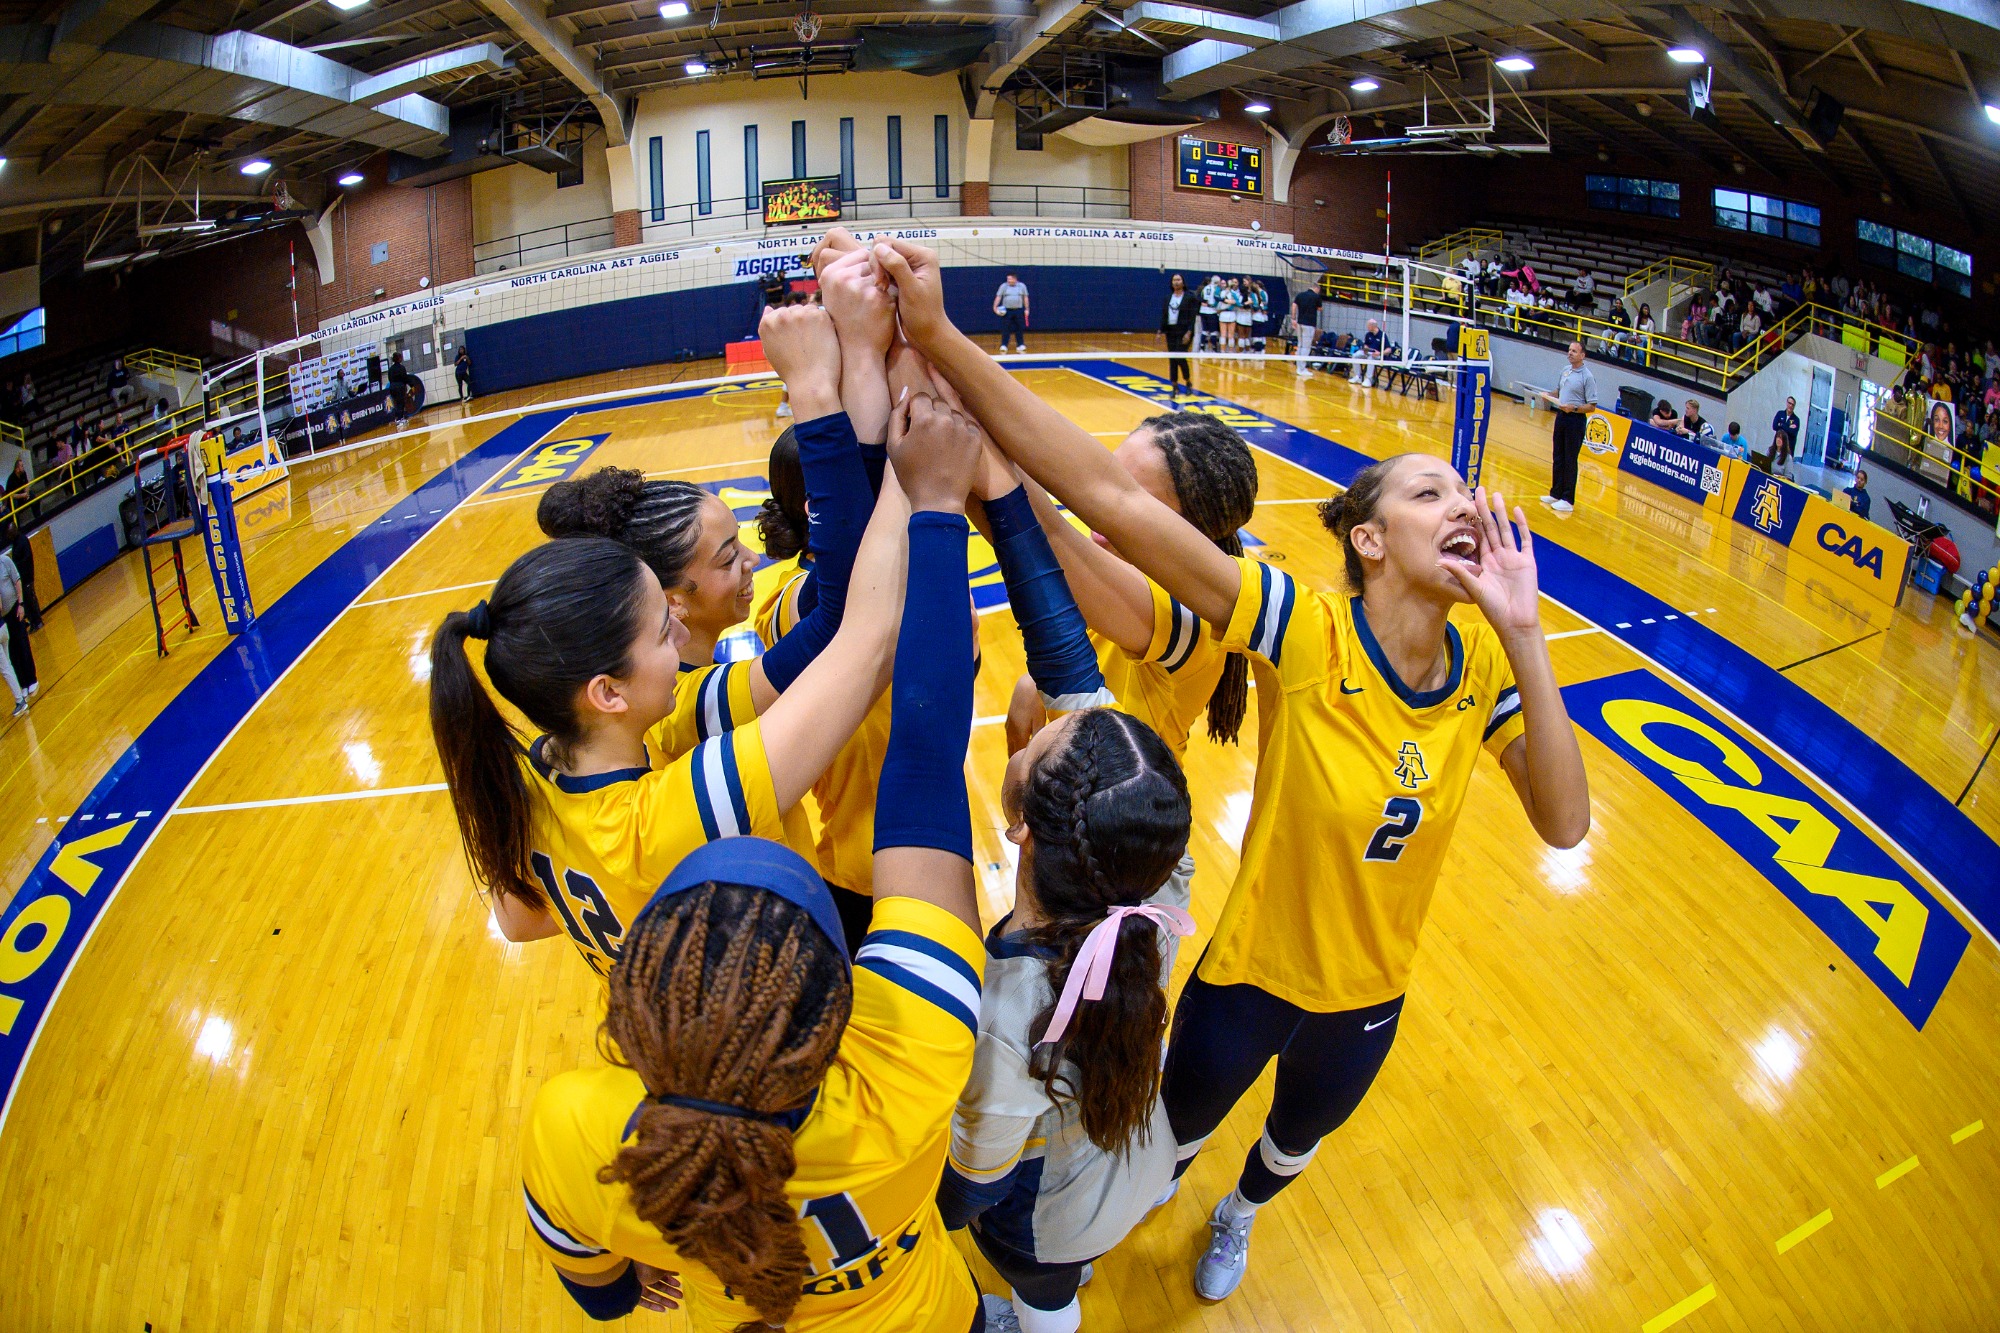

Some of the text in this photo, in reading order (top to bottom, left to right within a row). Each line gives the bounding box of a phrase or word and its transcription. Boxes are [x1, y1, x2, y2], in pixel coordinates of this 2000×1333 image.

[757, 238, 797, 249] NORTH
[896, 229, 937, 239] AGGIES
[1013, 228, 1174, 241] NORTH CAROLINA A&T AGGIES
[1237, 239, 1364, 260] NORTH CAROLINA A&T AGGIES
[511, 251, 679, 288] NORTH CAROLINA A&T AGGIES
[736, 255, 802, 276] AGGIES
[311, 296, 445, 341] NORTH CAROLINA A&T AGGIES
[375, 403, 383, 412] DJ
[315, 422, 324, 432] DJ
[1466, 373, 1486, 489] PRIDE
[499, 439, 594, 489] CAA
[1629, 451, 1696, 487] aggieboosters.com
[1631, 436, 1657, 457] JOIN
[1659, 446, 1699, 474] TODAY!
[1816, 522, 1884, 580] CAA
[1362, 796, 1424, 863] 2
[1601, 699, 1930, 989] CAA
[531, 849, 626, 961] 12
